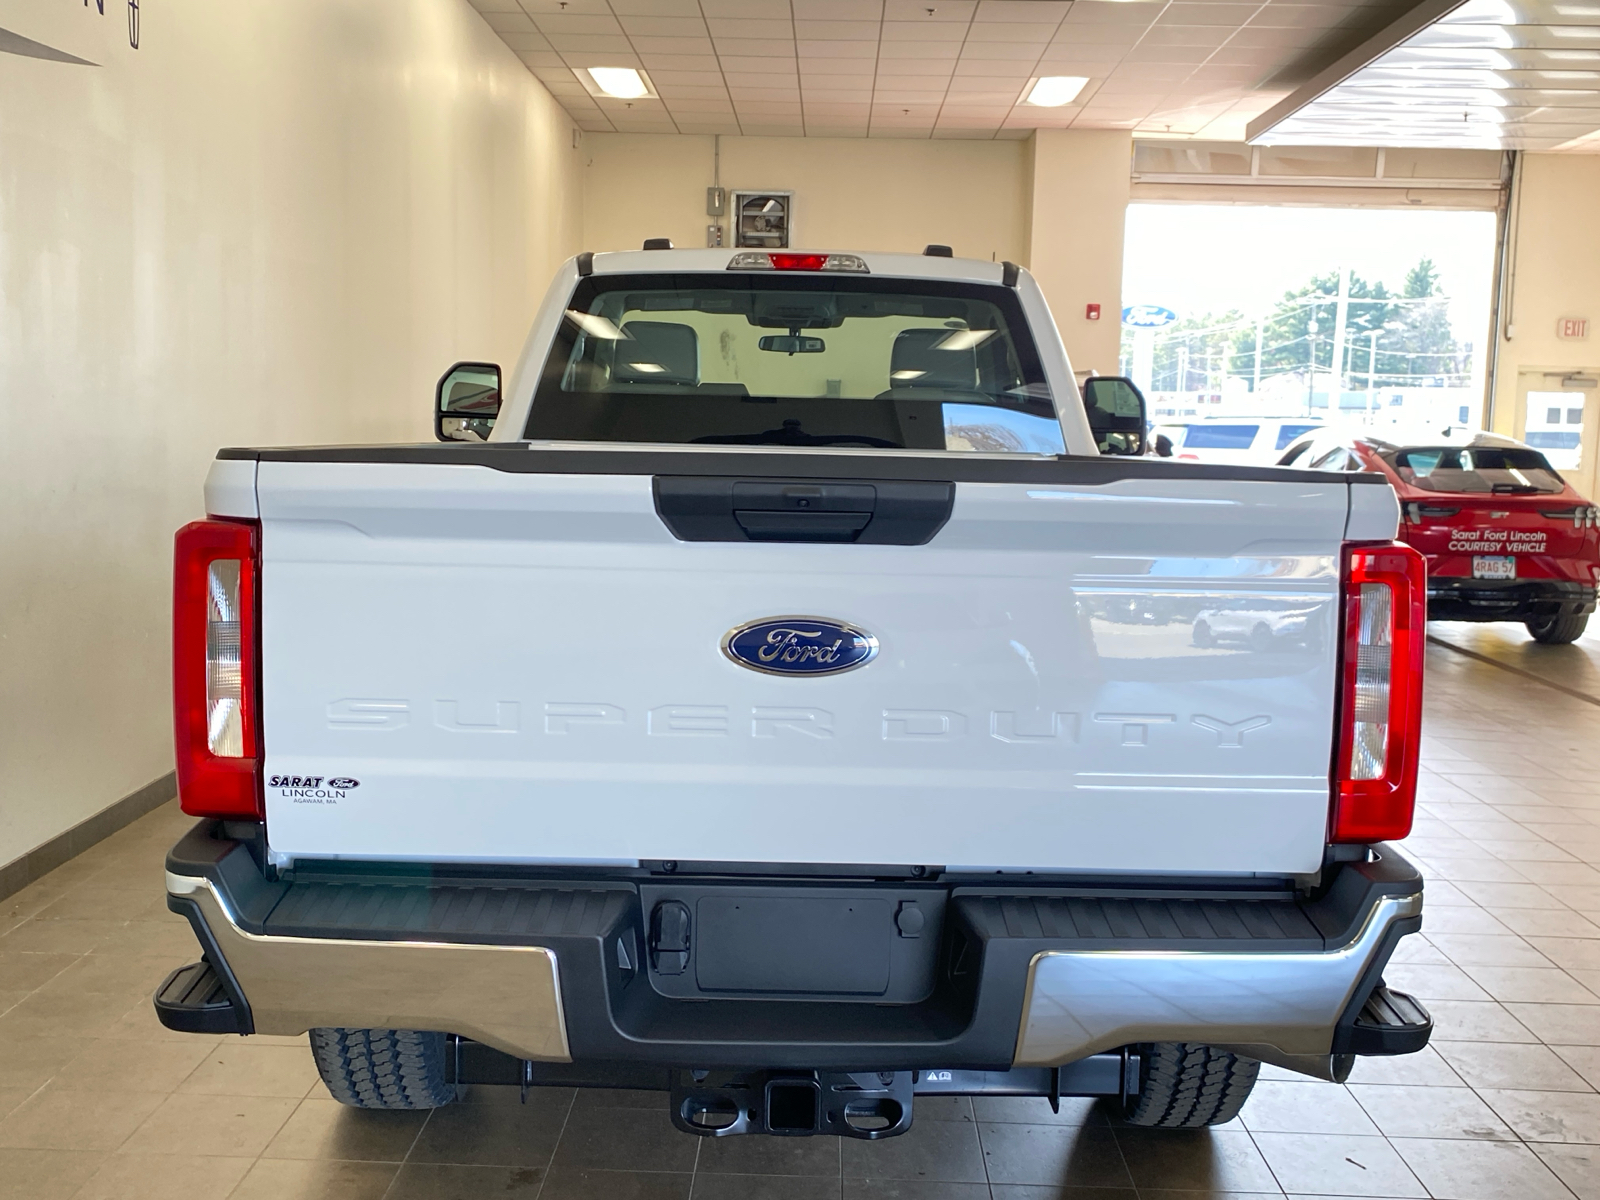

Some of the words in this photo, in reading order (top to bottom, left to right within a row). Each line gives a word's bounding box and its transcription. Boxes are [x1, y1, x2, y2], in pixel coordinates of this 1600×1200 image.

[1564, 319, 1586, 337] EXIT
[1451, 529, 1480, 540] Sarat
[1483, 530, 1507, 541] Ford
[1510, 531, 1546, 541] Lincoln
[1448, 540, 1503, 552] COURTESY
[1506, 542, 1546, 553] VEHICLE
[1474, 561, 1499, 573] 4RAG
[1501, 562, 1514, 573] 57
[758, 628, 842, 663] Ford
[327, 697, 835, 740] SUPER
[882, 708, 1272, 749] DUTY
[269, 776, 324, 788] SARAT
[332, 778, 356, 788] Ford
[282, 789, 346, 798] LINCOLN
